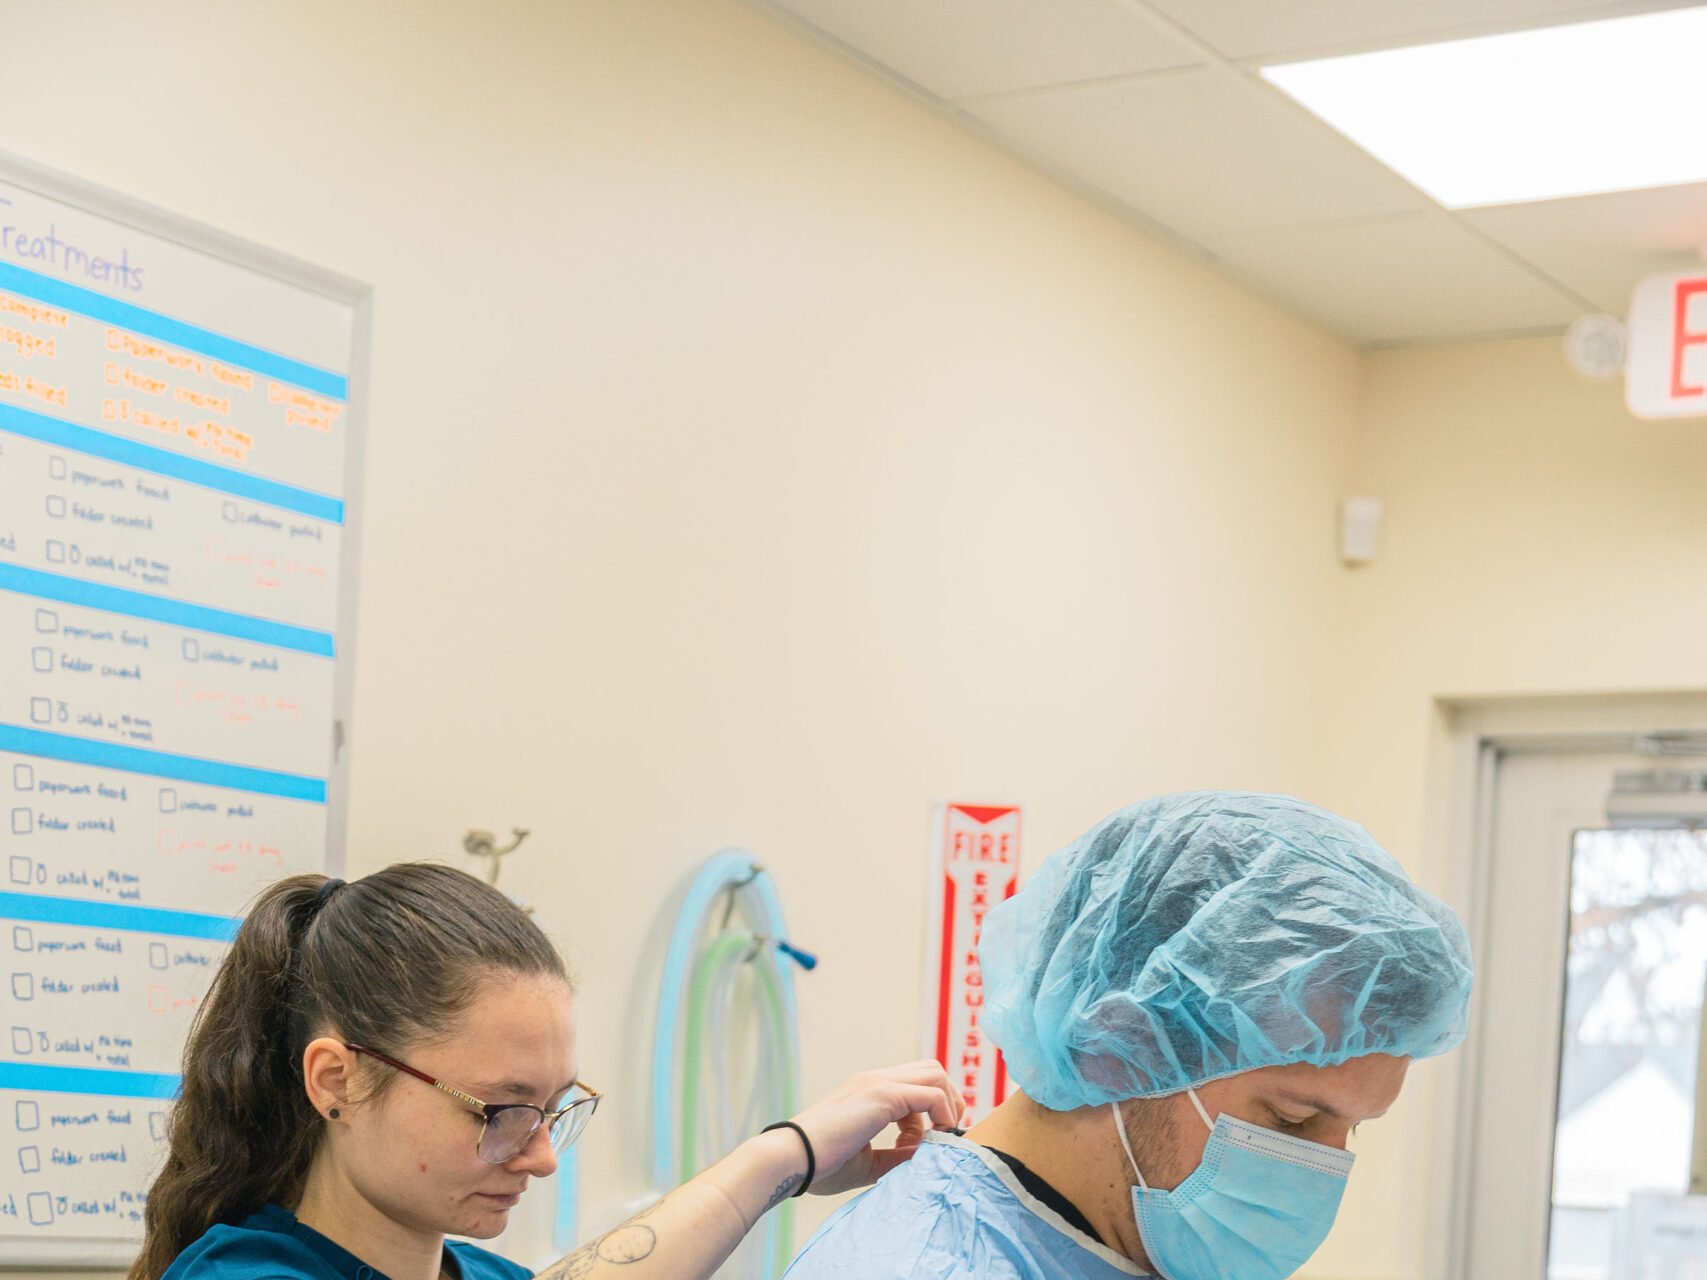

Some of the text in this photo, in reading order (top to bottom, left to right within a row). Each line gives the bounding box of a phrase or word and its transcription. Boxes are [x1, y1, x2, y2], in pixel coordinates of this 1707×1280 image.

[0, 205, 144, 291] reatments
[953, 832, 1010, 863] FIRE
[51, 1144, 126, 1166] folder created
[72, 1200, 99, 1214] called
